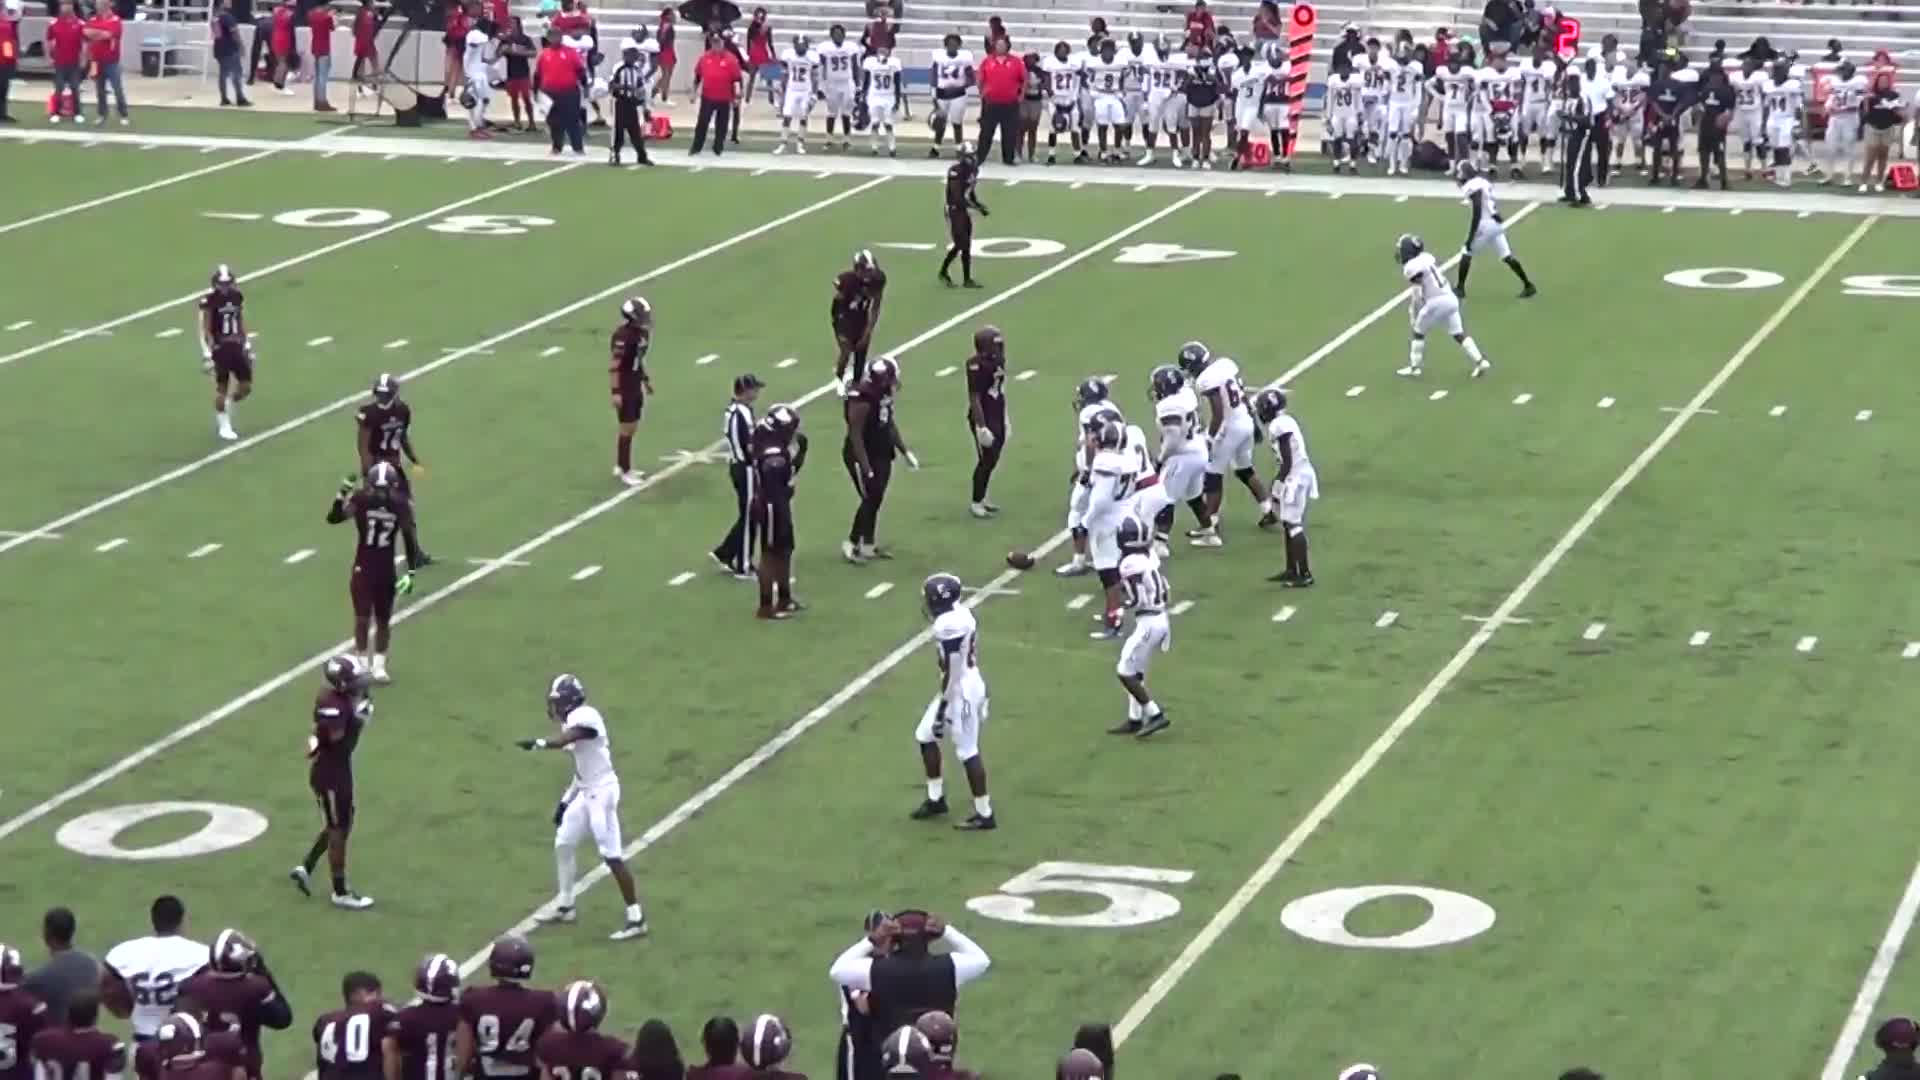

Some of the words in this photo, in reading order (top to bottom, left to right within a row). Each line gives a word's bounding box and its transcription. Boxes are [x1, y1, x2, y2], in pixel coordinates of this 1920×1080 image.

[1557, 18, 1581, 58] 2
[1055, 73, 1072, 90] 27
[367, 518, 395, 548] 12
[320, 1013, 371, 1064] 40
[477, 1013, 535, 1052] 94
